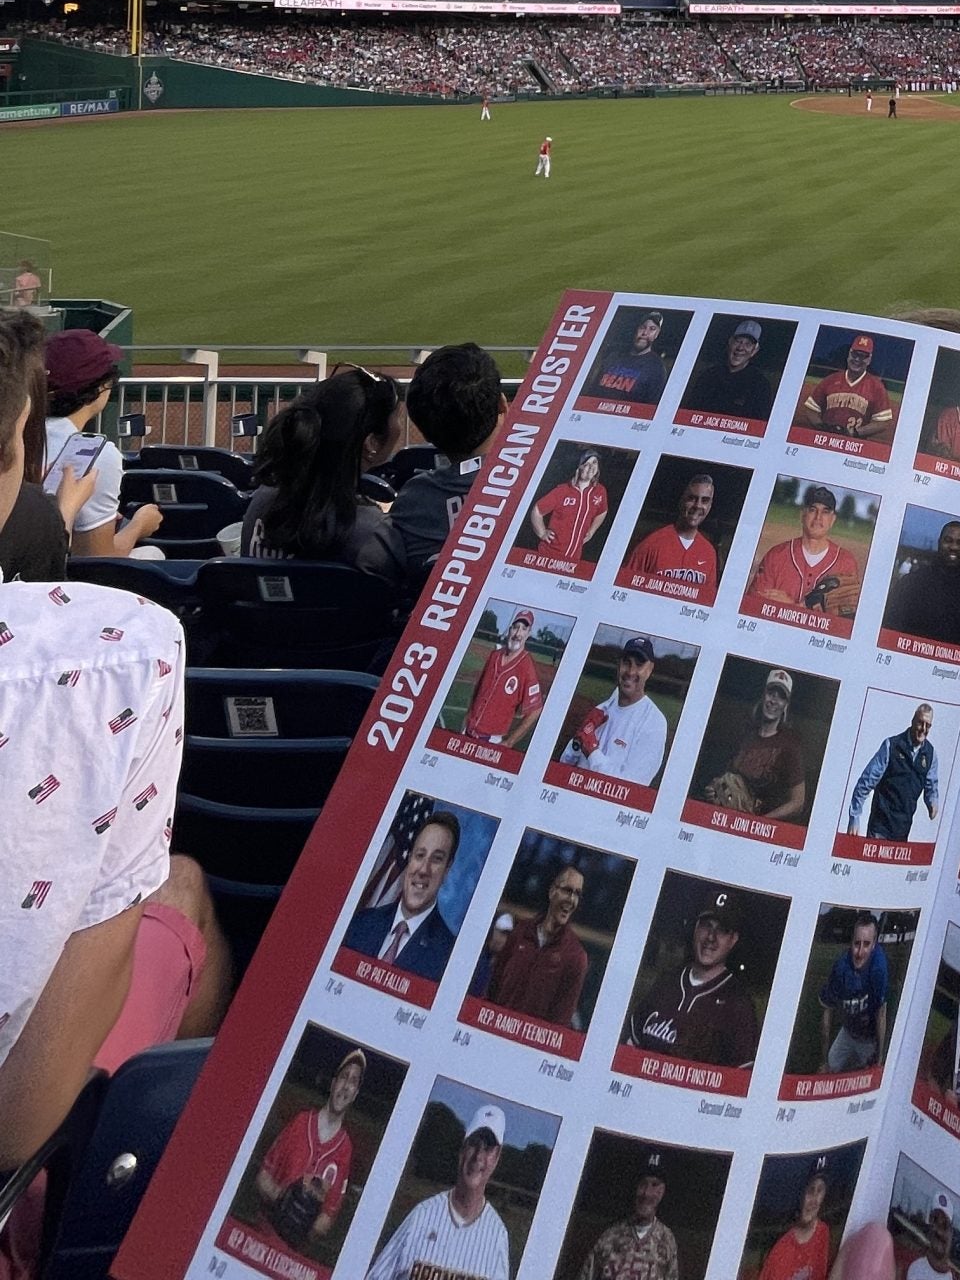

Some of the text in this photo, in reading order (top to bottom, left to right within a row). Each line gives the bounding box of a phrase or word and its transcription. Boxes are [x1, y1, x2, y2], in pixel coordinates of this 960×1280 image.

[578, 5, 617, 13] ClearPath.org
[70, 102, 109, 114] RE/MAX
[691, 414, 749, 432] REP. JACK BERGMAN
[814, 434, 864, 453] REP. MIKE BOST
[935, 461, 949, 475] REP.
[367, 303, 596, 752] 2023 REPUBLICAN ROSTER
[524, 554, 536, 565] REP.
[536, 557, 548, 568] KAT
[631, 575, 645, 587] REP.
[645, 579, 664, 592] JUAN
[663, 583, 699, 599] CISCOMANI
[761, 604, 831, 630] REP. ANDREW CLYDE
[897, 637, 911, 651] REP.
[912, 640, 934, 656] BYRON
[446, 738, 460, 751] REP.
[460, 741, 477, 755] JEFF
[568, 773, 630, 800] REP. JAKE ELLZEY
[711, 811, 776, 838] SEN. JONI ERNST
[770, 850, 783, 865] Left
[863, 844, 912, 861] REP. MIKE EZELL
[716, 894, 727, 906] C
[355, 961, 410, 994] REP. PAT FALLON
[478, 1008, 564, 1049] REP. RANDY FEENSTRA
[641, 1058, 722, 1088] REP. BRAD FINSTAD
[796, 1081, 813, 1096] REP.
[813, 1079, 834, 1096] BRIAN
[928, 1097, 942, 1118] REP.
